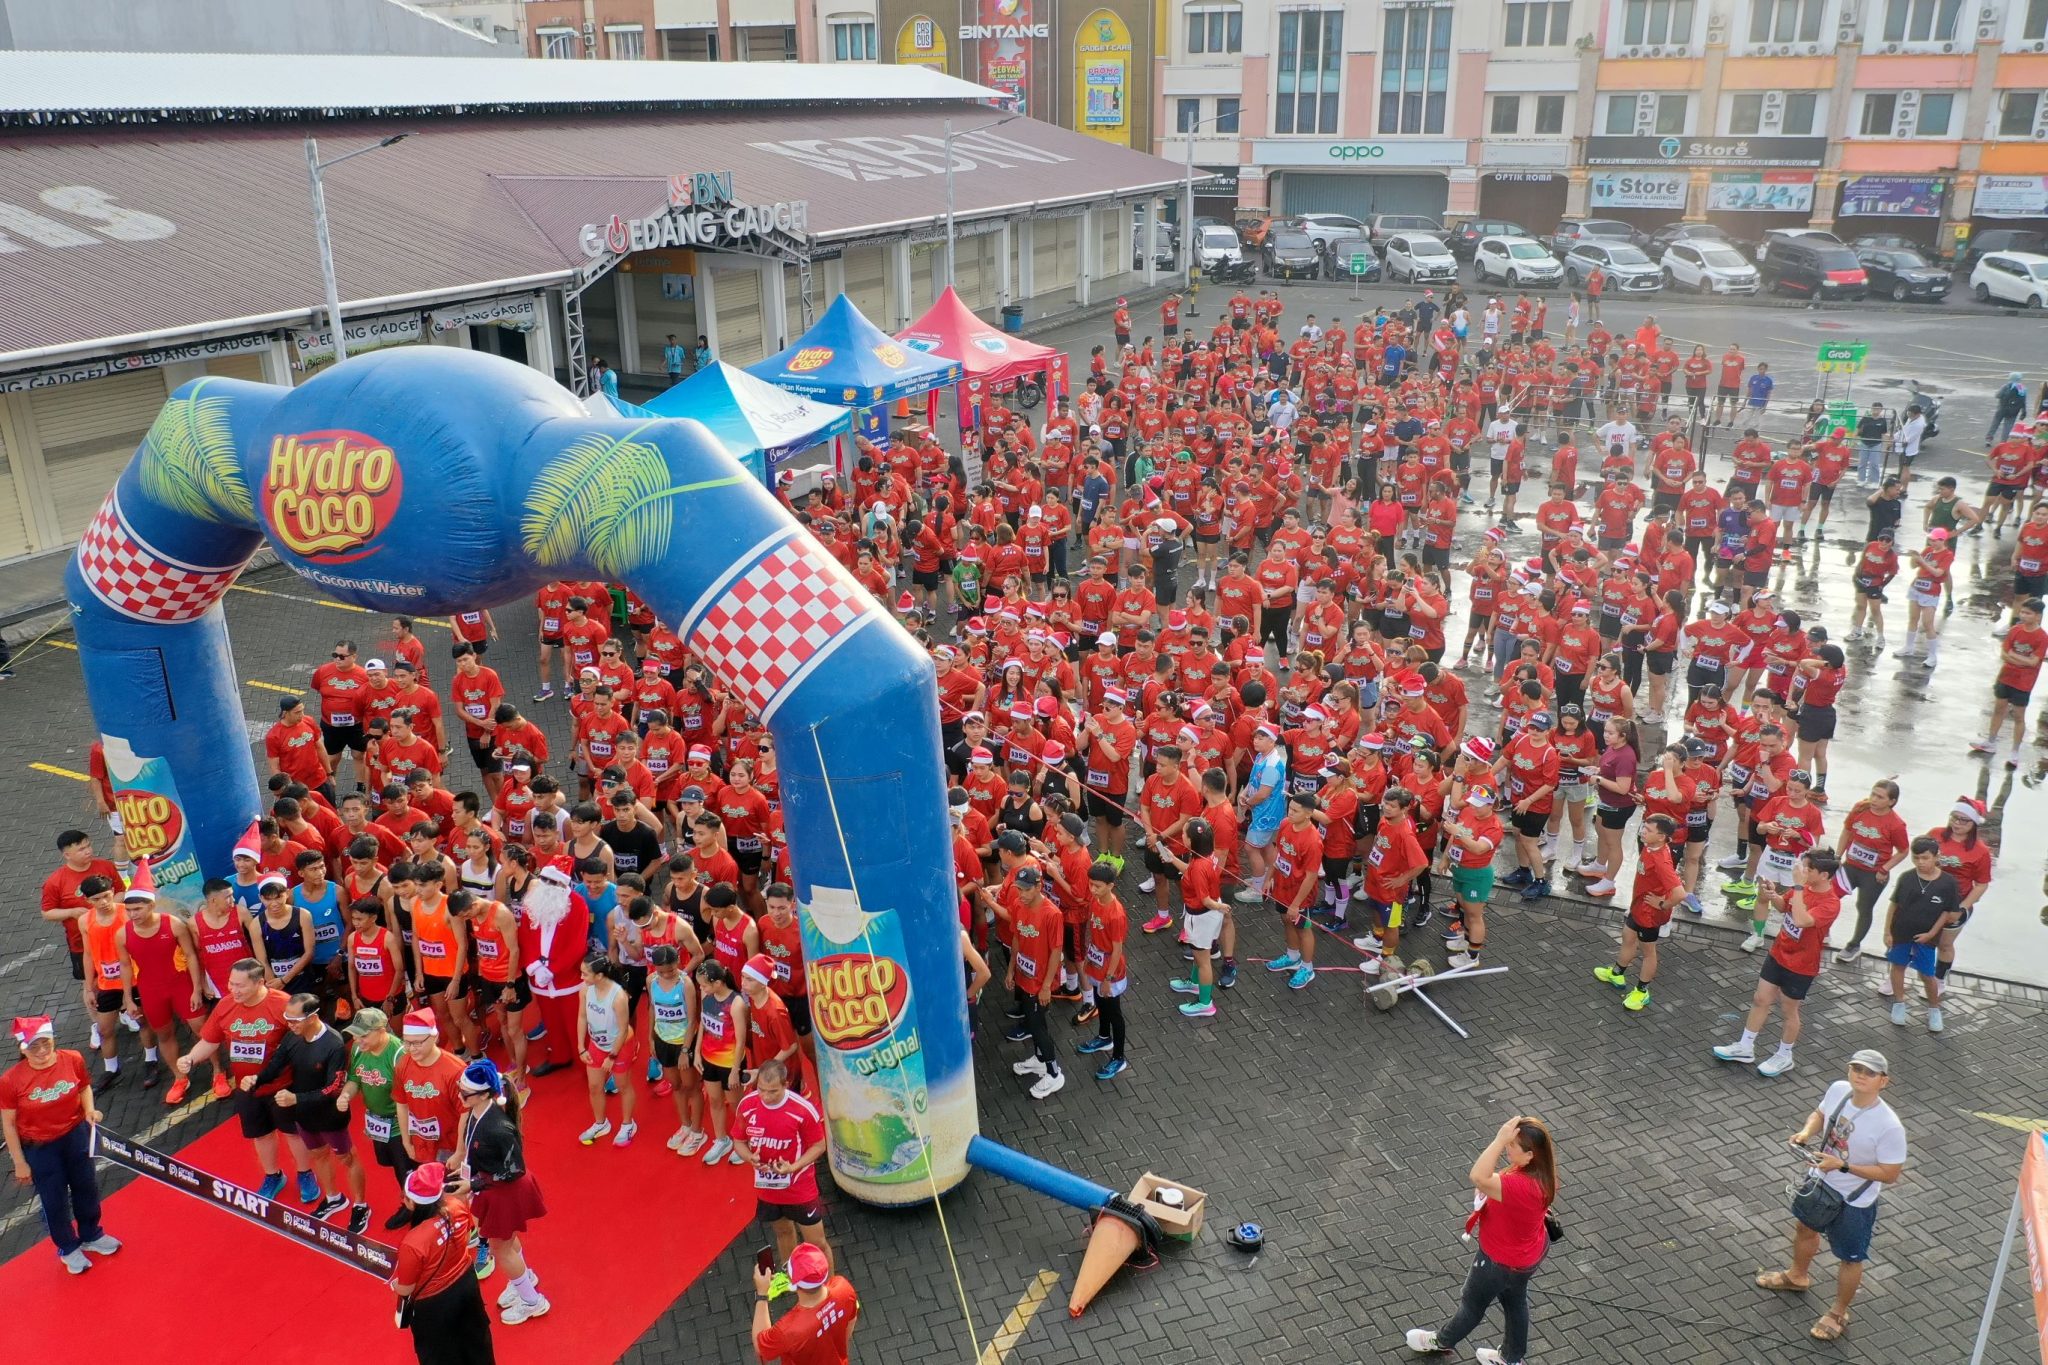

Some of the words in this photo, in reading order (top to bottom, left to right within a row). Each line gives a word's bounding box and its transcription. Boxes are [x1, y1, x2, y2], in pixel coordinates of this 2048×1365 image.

[959, 24, 1049, 40] BINTANG
[916, 34, 931, 46] CUS
[1329, 146, 1384, 160] oppo
[1689, 142, 1749, 157] Store
[694, 170, 734, 204] BNI
[1620, 177, 1680, 194] Store
[724, 200, 809, 238] GADGET
[490, 302, 534, 318] GADGET
[370, 318, 420, 336] GADGET
[204, 334, 271, 358] GADGET
[794, 347, 834, 363] Hydro
[1828, 350, 1852, 359] Grab
[788, 358, 823, 372] Coco
[796, 384, 826, 394] Kesegaran
[1611, 434, 1625, 443] MRC
[270, 436, 394, 496] Hydro
[272, 488, 374, 555] Coco
[314, 571, 373, 592] Coconut
[373, 580, 426, 597] Water
[1090, 774, 1106, 782] 9571
[1297, 780, 1314, 789] 9211
[616, 856, 636, 865] 9362
[1769, 854, 1792, 866] 9528
[1852, 846, 1874, 861] 9078
[316, 928, 336, 938] 150
[422, 942, 443, 953] 9776
[356, 962, 380, 970] 9276
[808, 956, 896, 1001] Hydro
[588, 1002, 606, 1016] HOKA
[658, 1008, 683, 1018] 9294
[813, 992, 889, 1042] Coco
[230, 1018, 257, 1032] Santa
[254, 1018, 274, 1034] Run
[234, 1046, 263, 1056] 9288
[30, 1086, 57, 1100] Santa
[54, 1080, 76, 1095] Run
[749, 1113, 757, 1126] 4
[750, 1136, 792, 1150] SPIRIT
[212, 1180, 270, 1218] START
